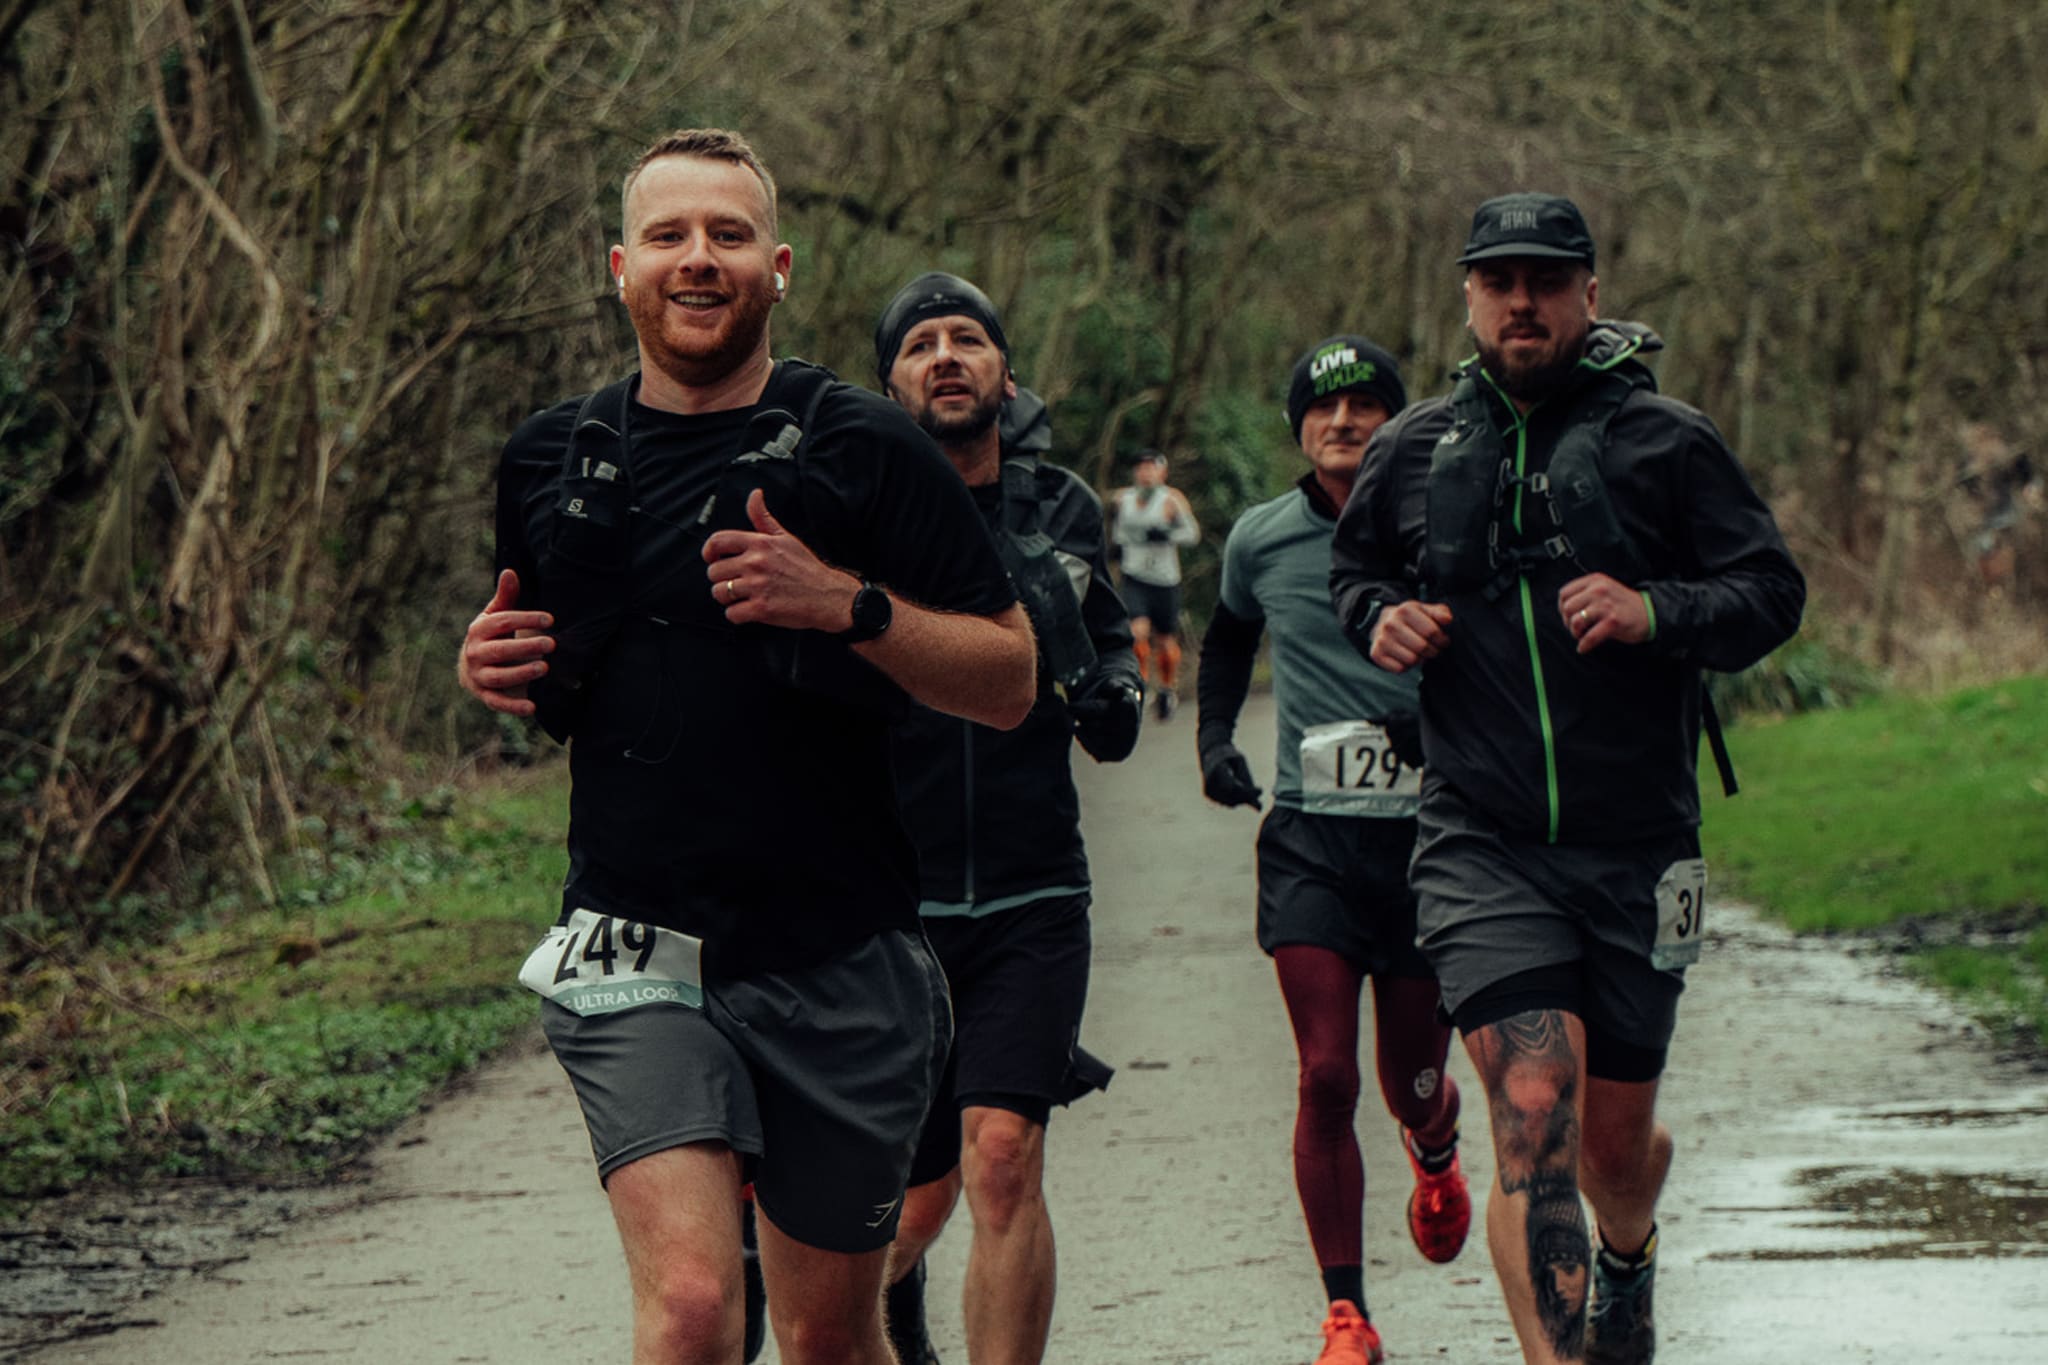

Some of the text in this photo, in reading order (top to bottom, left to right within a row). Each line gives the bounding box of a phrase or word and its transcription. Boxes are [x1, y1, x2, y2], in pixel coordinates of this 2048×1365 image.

[1336, 745, 1400, 789] 129
[553, 917, 657, 985] 249
[573, 990, 631, 1011] ULTRA
